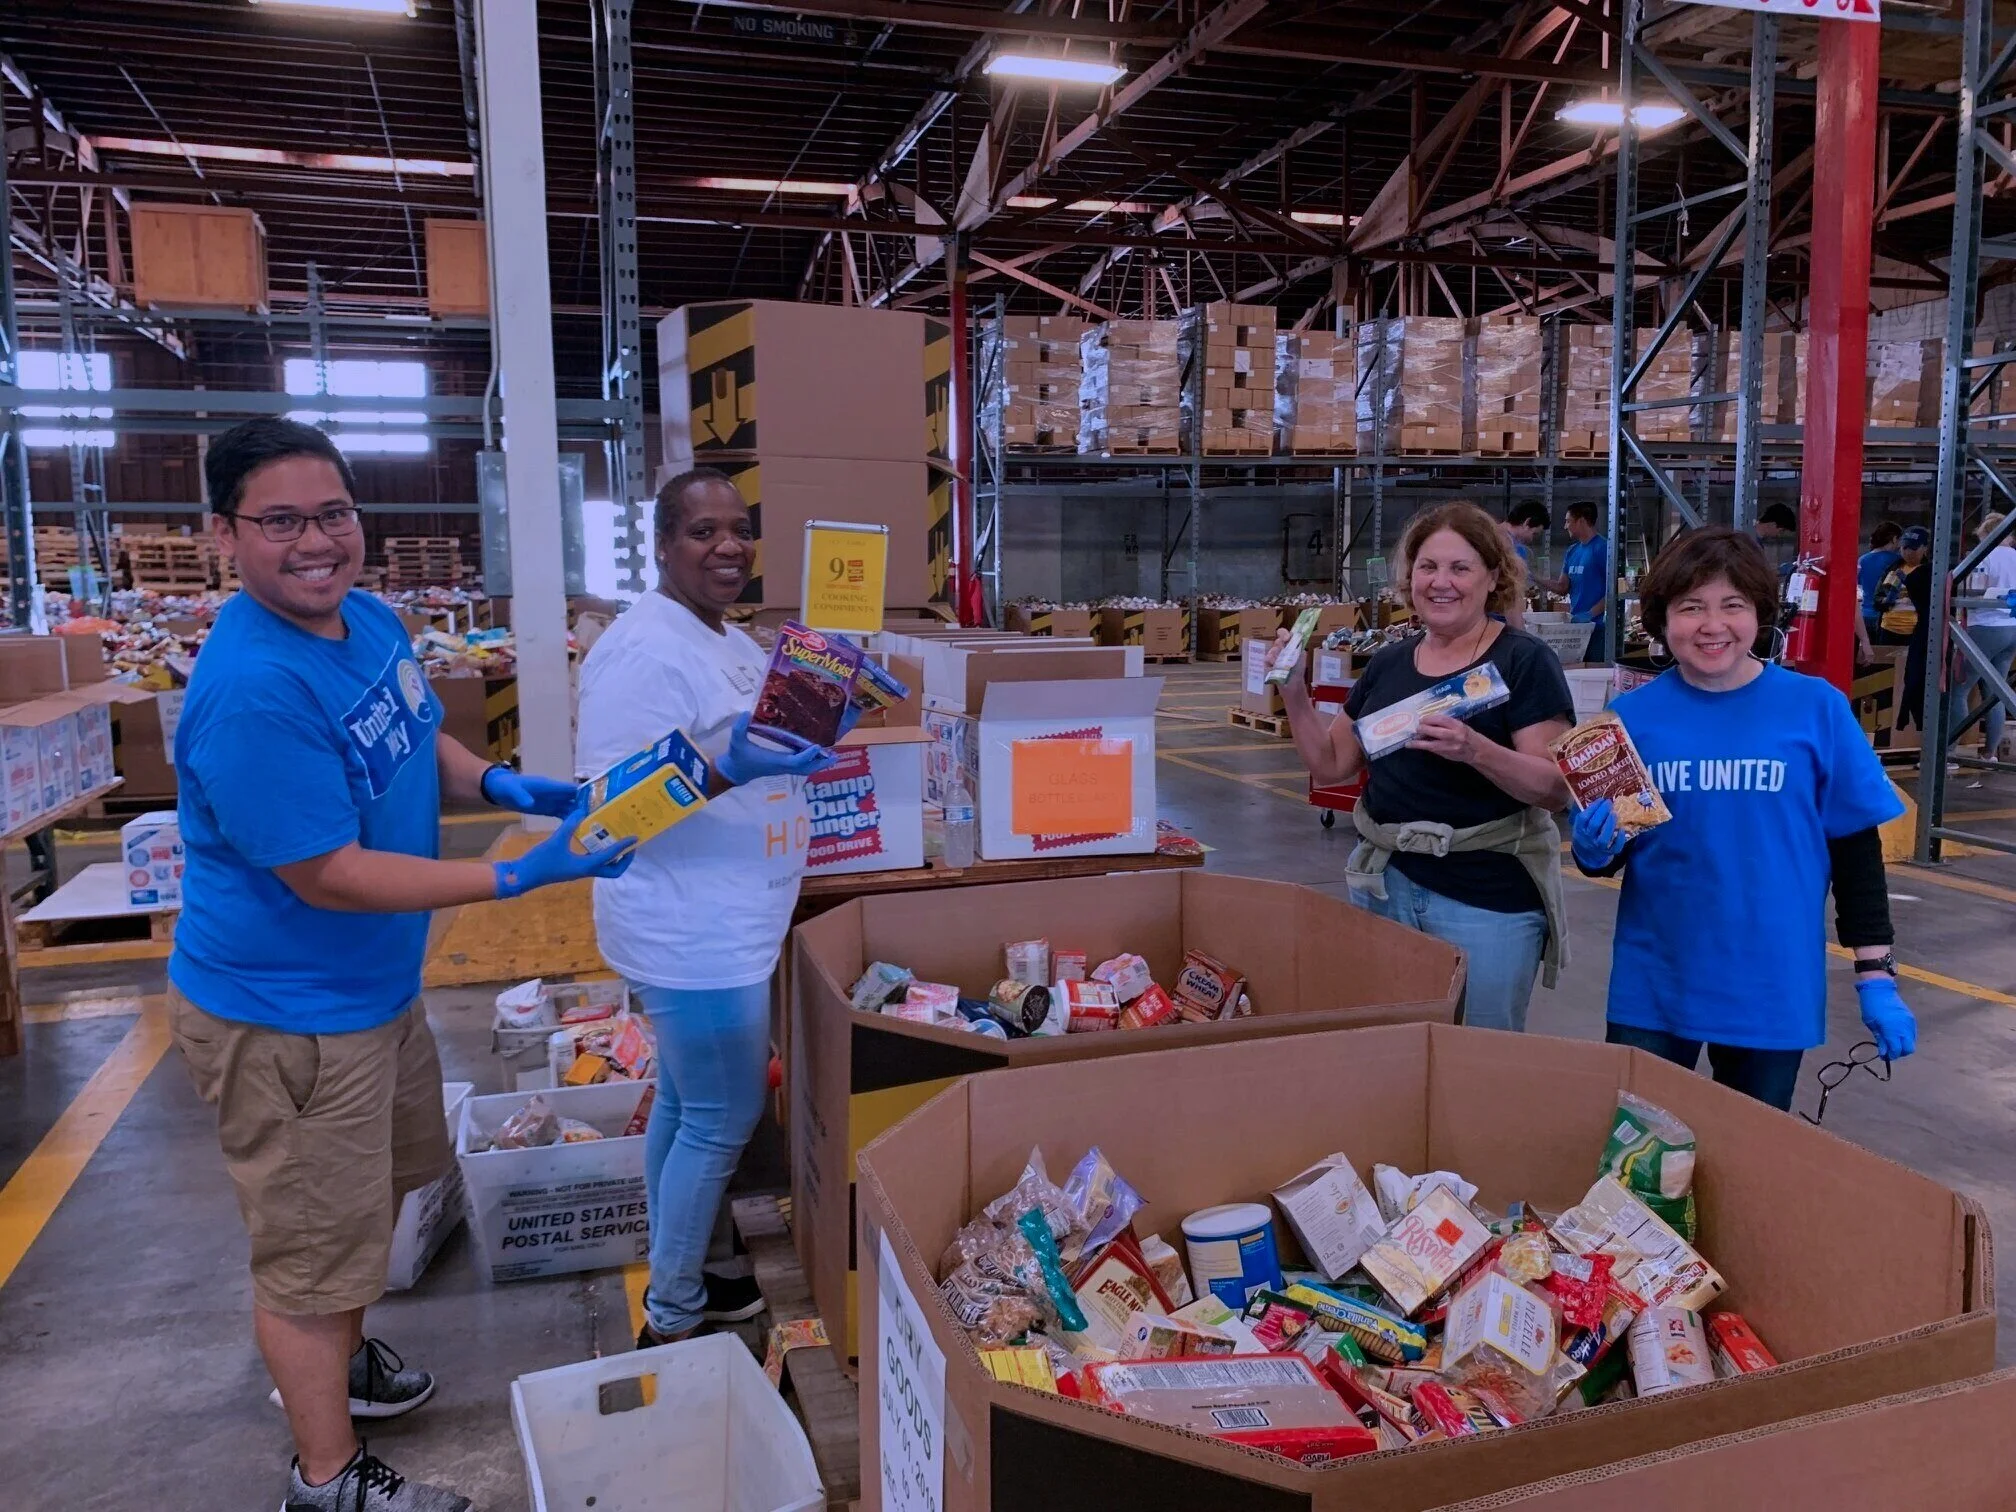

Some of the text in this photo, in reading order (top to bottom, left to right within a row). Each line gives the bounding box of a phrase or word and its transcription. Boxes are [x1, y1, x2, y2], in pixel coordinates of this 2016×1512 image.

[733, 16, 834, 39] NO SMOKING
[1307, 530, 1324, 556] 4
[829, 557, 845, 582] 9
[821, 593, 868, 602] COOKING
[782, 636, 856, 679] SuperMoist
[350, 686, 399, 748] United
[1567, 731, 1618, 771] IDAHOAN
[803, 775, 874, 800] tamp
[1048, 773, 1098, 785] GLASS
[1577, 770, 1608, 790] LOADED
[1699, 758, 1785, 792] UNITED
[836, 837, 873, 852] DRIVE
[1186, 979, 1217, 999] WHEAT
[1189, 971, 1219, 993] CREAM
[1148, 994, 1163, 1010] RICE
[509, 1175, 644, 1198] WARNING NOT FOR PRIVATE USE
[508, 1201, 648, 1231] UNITED STATES
[502, 1231, 573, 1250] POSTAL
[1096, 1278, 1130, 1302] EAGLE
[1316, 1301, 1379, 1331] Vanilla Creme
[895, 1296, 922, 1372] DRY
[1520, 1300, 1536, 1358] PIZZELLE
[887, 1336, 932, 1460] GOODS
